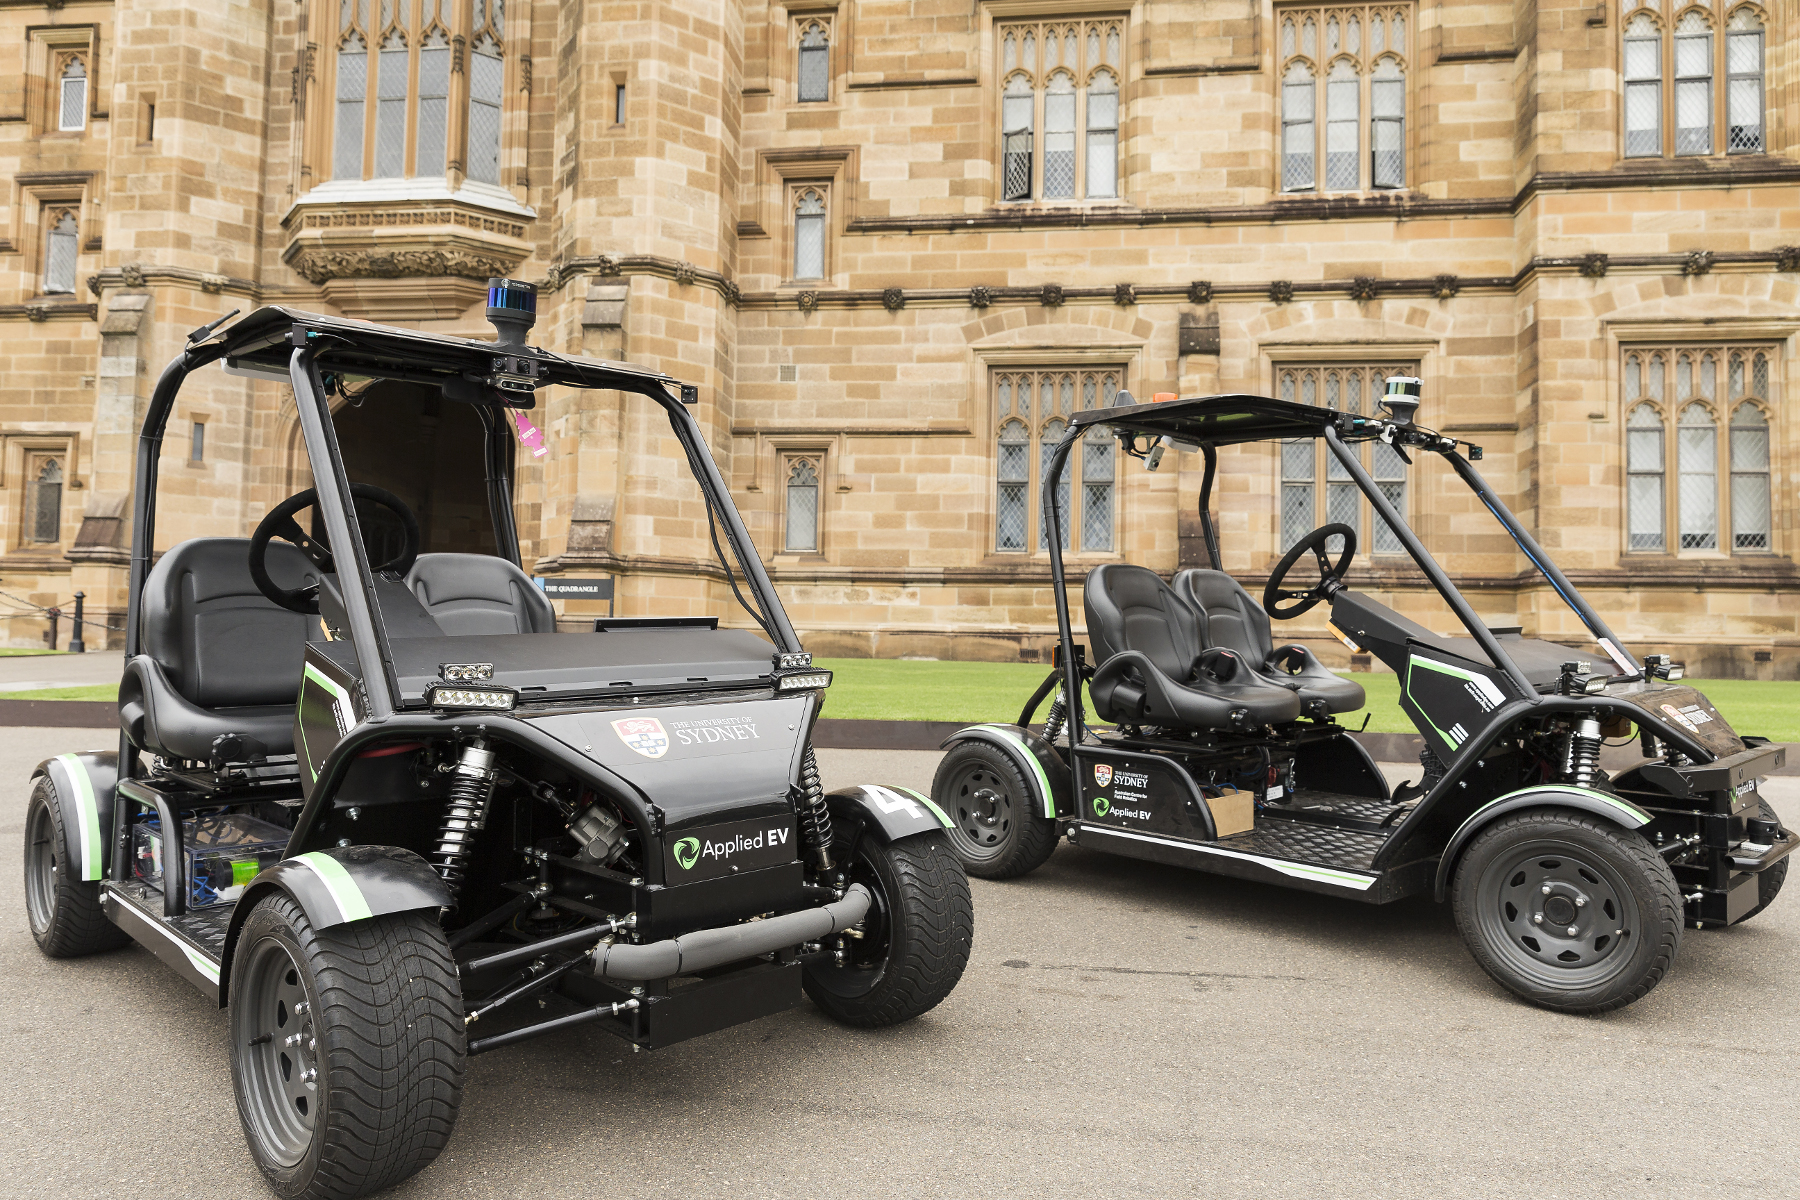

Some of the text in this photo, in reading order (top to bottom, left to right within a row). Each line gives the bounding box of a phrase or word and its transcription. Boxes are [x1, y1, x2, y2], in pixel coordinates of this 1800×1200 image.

[558, 585, 599, 593] QUADRANGLE
[670, 721, 690, 729] THE
[690, 717, 740, 727] UNIVERSITY
[676, 724, 760, 744] SYDNEY
[1114, 775, 1149, 788] SYDNEY
[857, 784, 924, 820] 4
[1109, 806, 1151, 820] Applied EV
[702, 827, 789, 860] Applied EV
